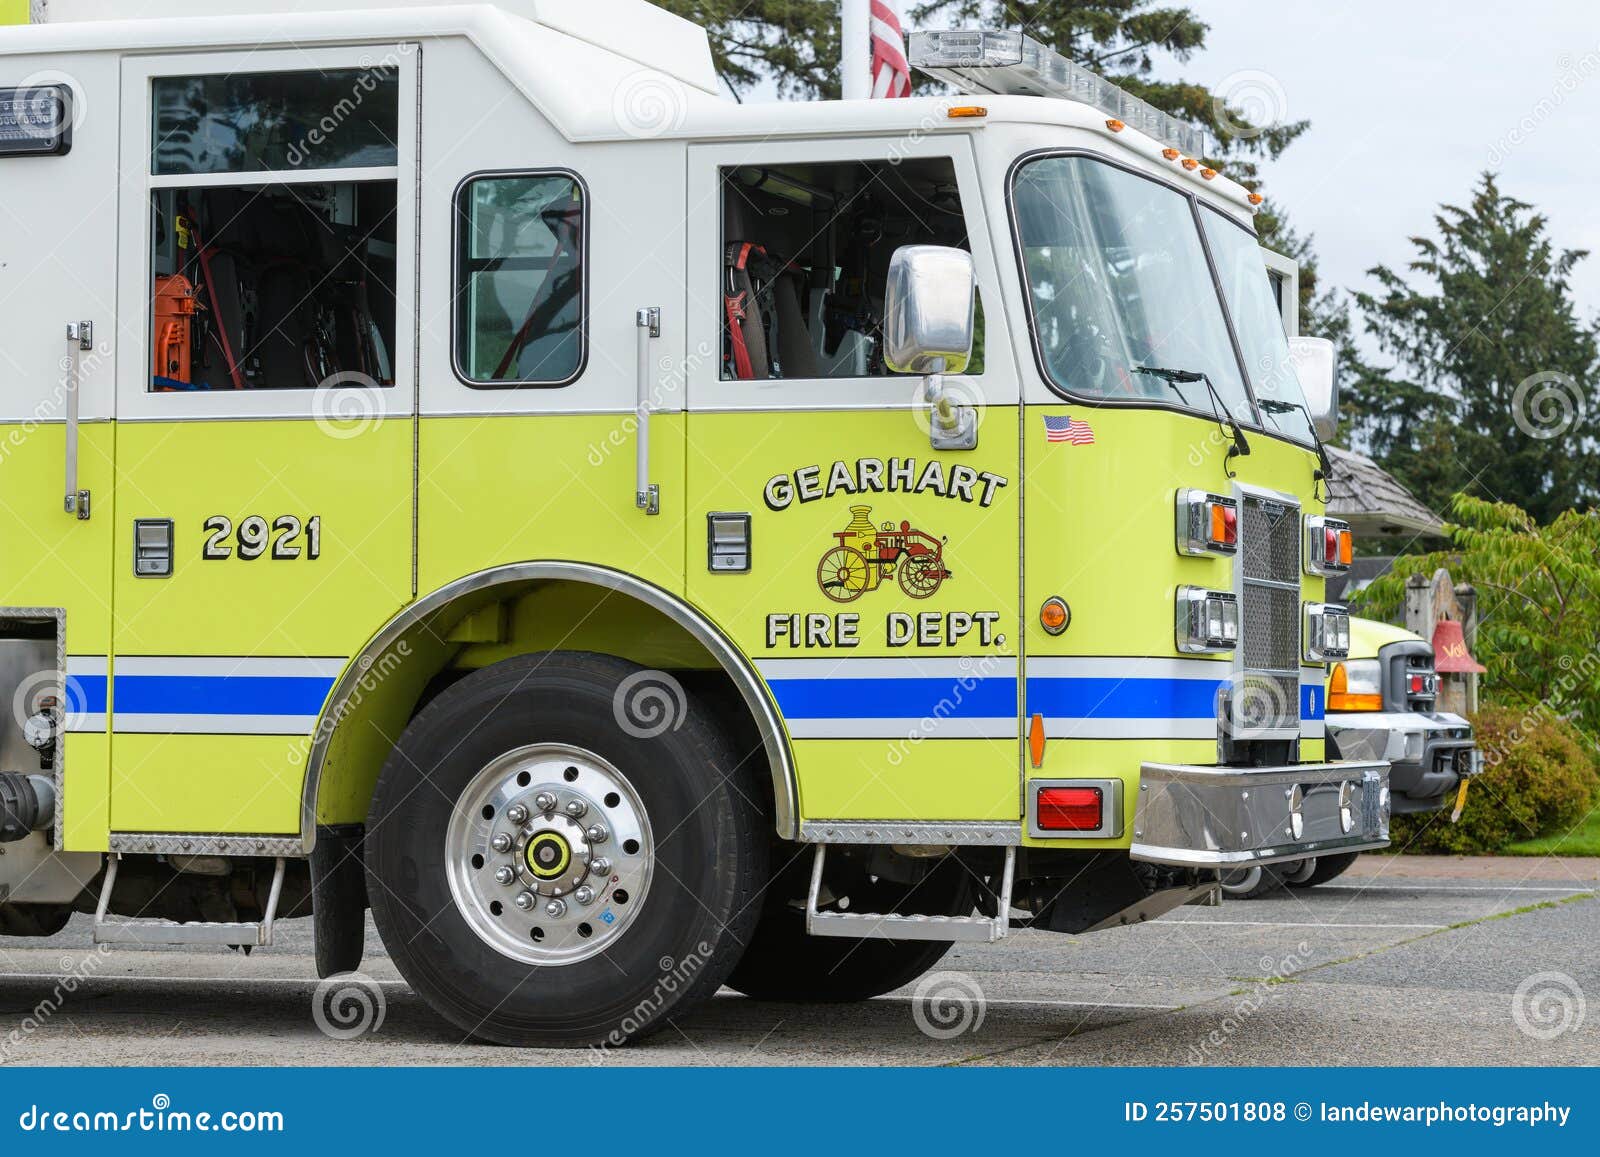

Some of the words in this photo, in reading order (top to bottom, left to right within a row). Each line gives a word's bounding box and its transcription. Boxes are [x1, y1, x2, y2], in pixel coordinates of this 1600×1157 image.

[763, 457, 1008, 511] GEARHART
[203, 514, 321, 561] 2921
[766, 612, 860, 648] FIRE
[886, 611, 1006, 648] DEPT.
